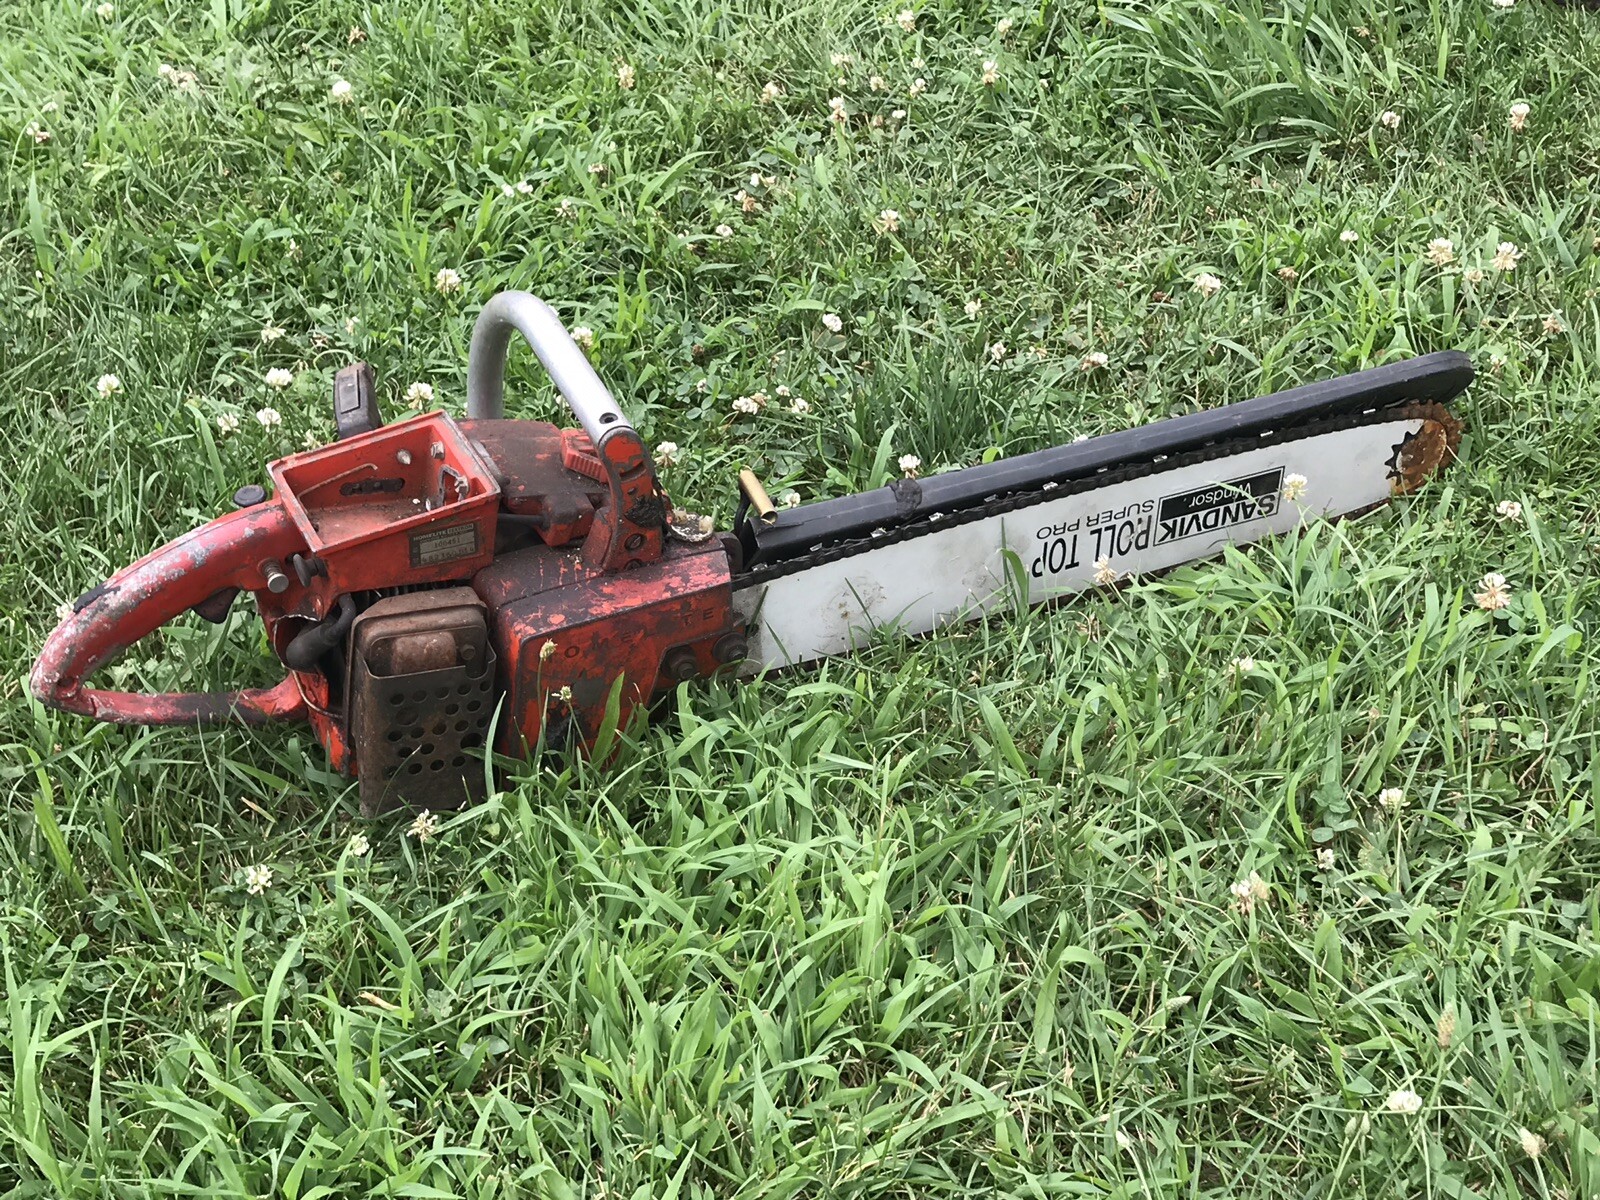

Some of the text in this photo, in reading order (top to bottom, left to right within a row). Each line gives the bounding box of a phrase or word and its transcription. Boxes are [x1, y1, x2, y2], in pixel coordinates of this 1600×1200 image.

[1189, 482, 1251, 508] Windsor
[413, 529, 447, 541] HOMELITE
[1036, 499, 1155, 540] SUPER PRO
[1158, 494, 1277, 542] SANDVIK
[1031, 515, 1153, 578] ROLL TOP
